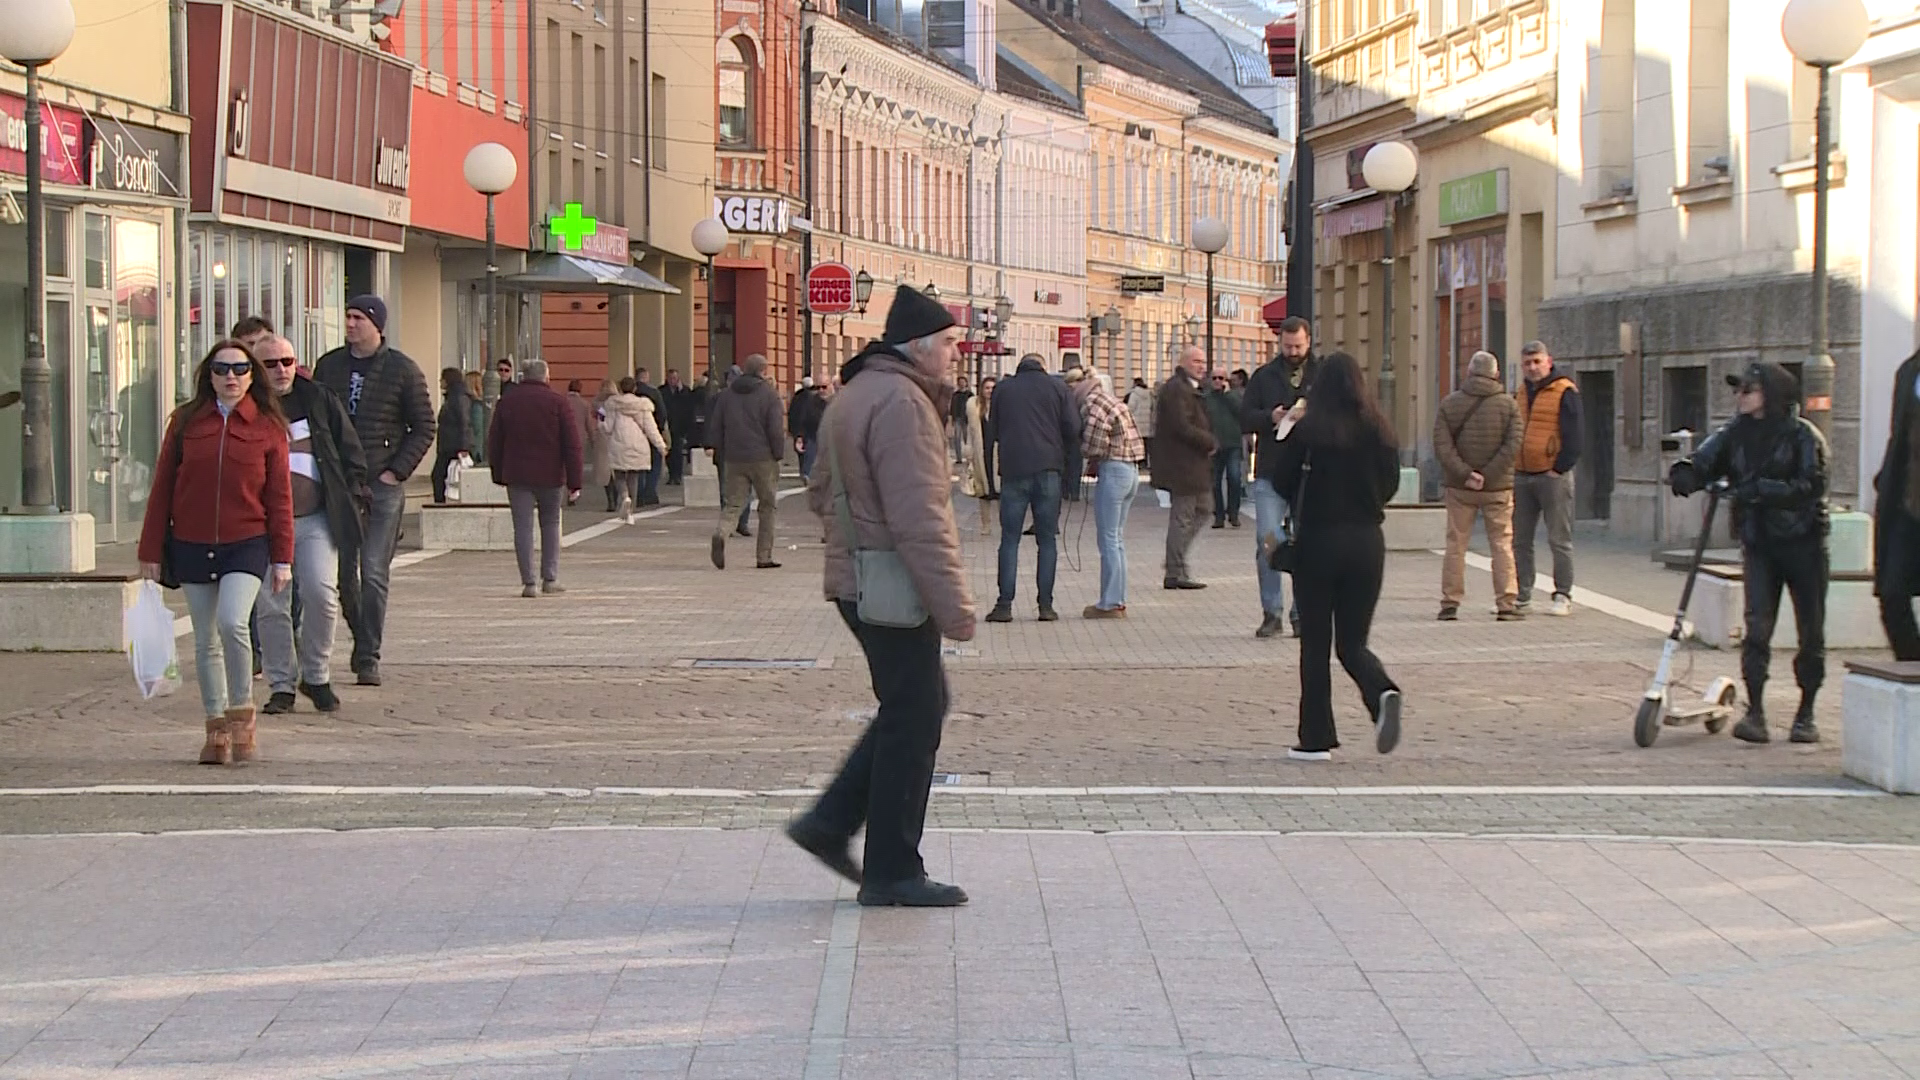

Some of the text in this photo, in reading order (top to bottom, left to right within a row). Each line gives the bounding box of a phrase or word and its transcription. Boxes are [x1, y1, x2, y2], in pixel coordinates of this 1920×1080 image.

[115, 133, 159, 197] Bonatti
[809, 280, 852, 289] BURGER
[809, 290, 851, 303] KING
